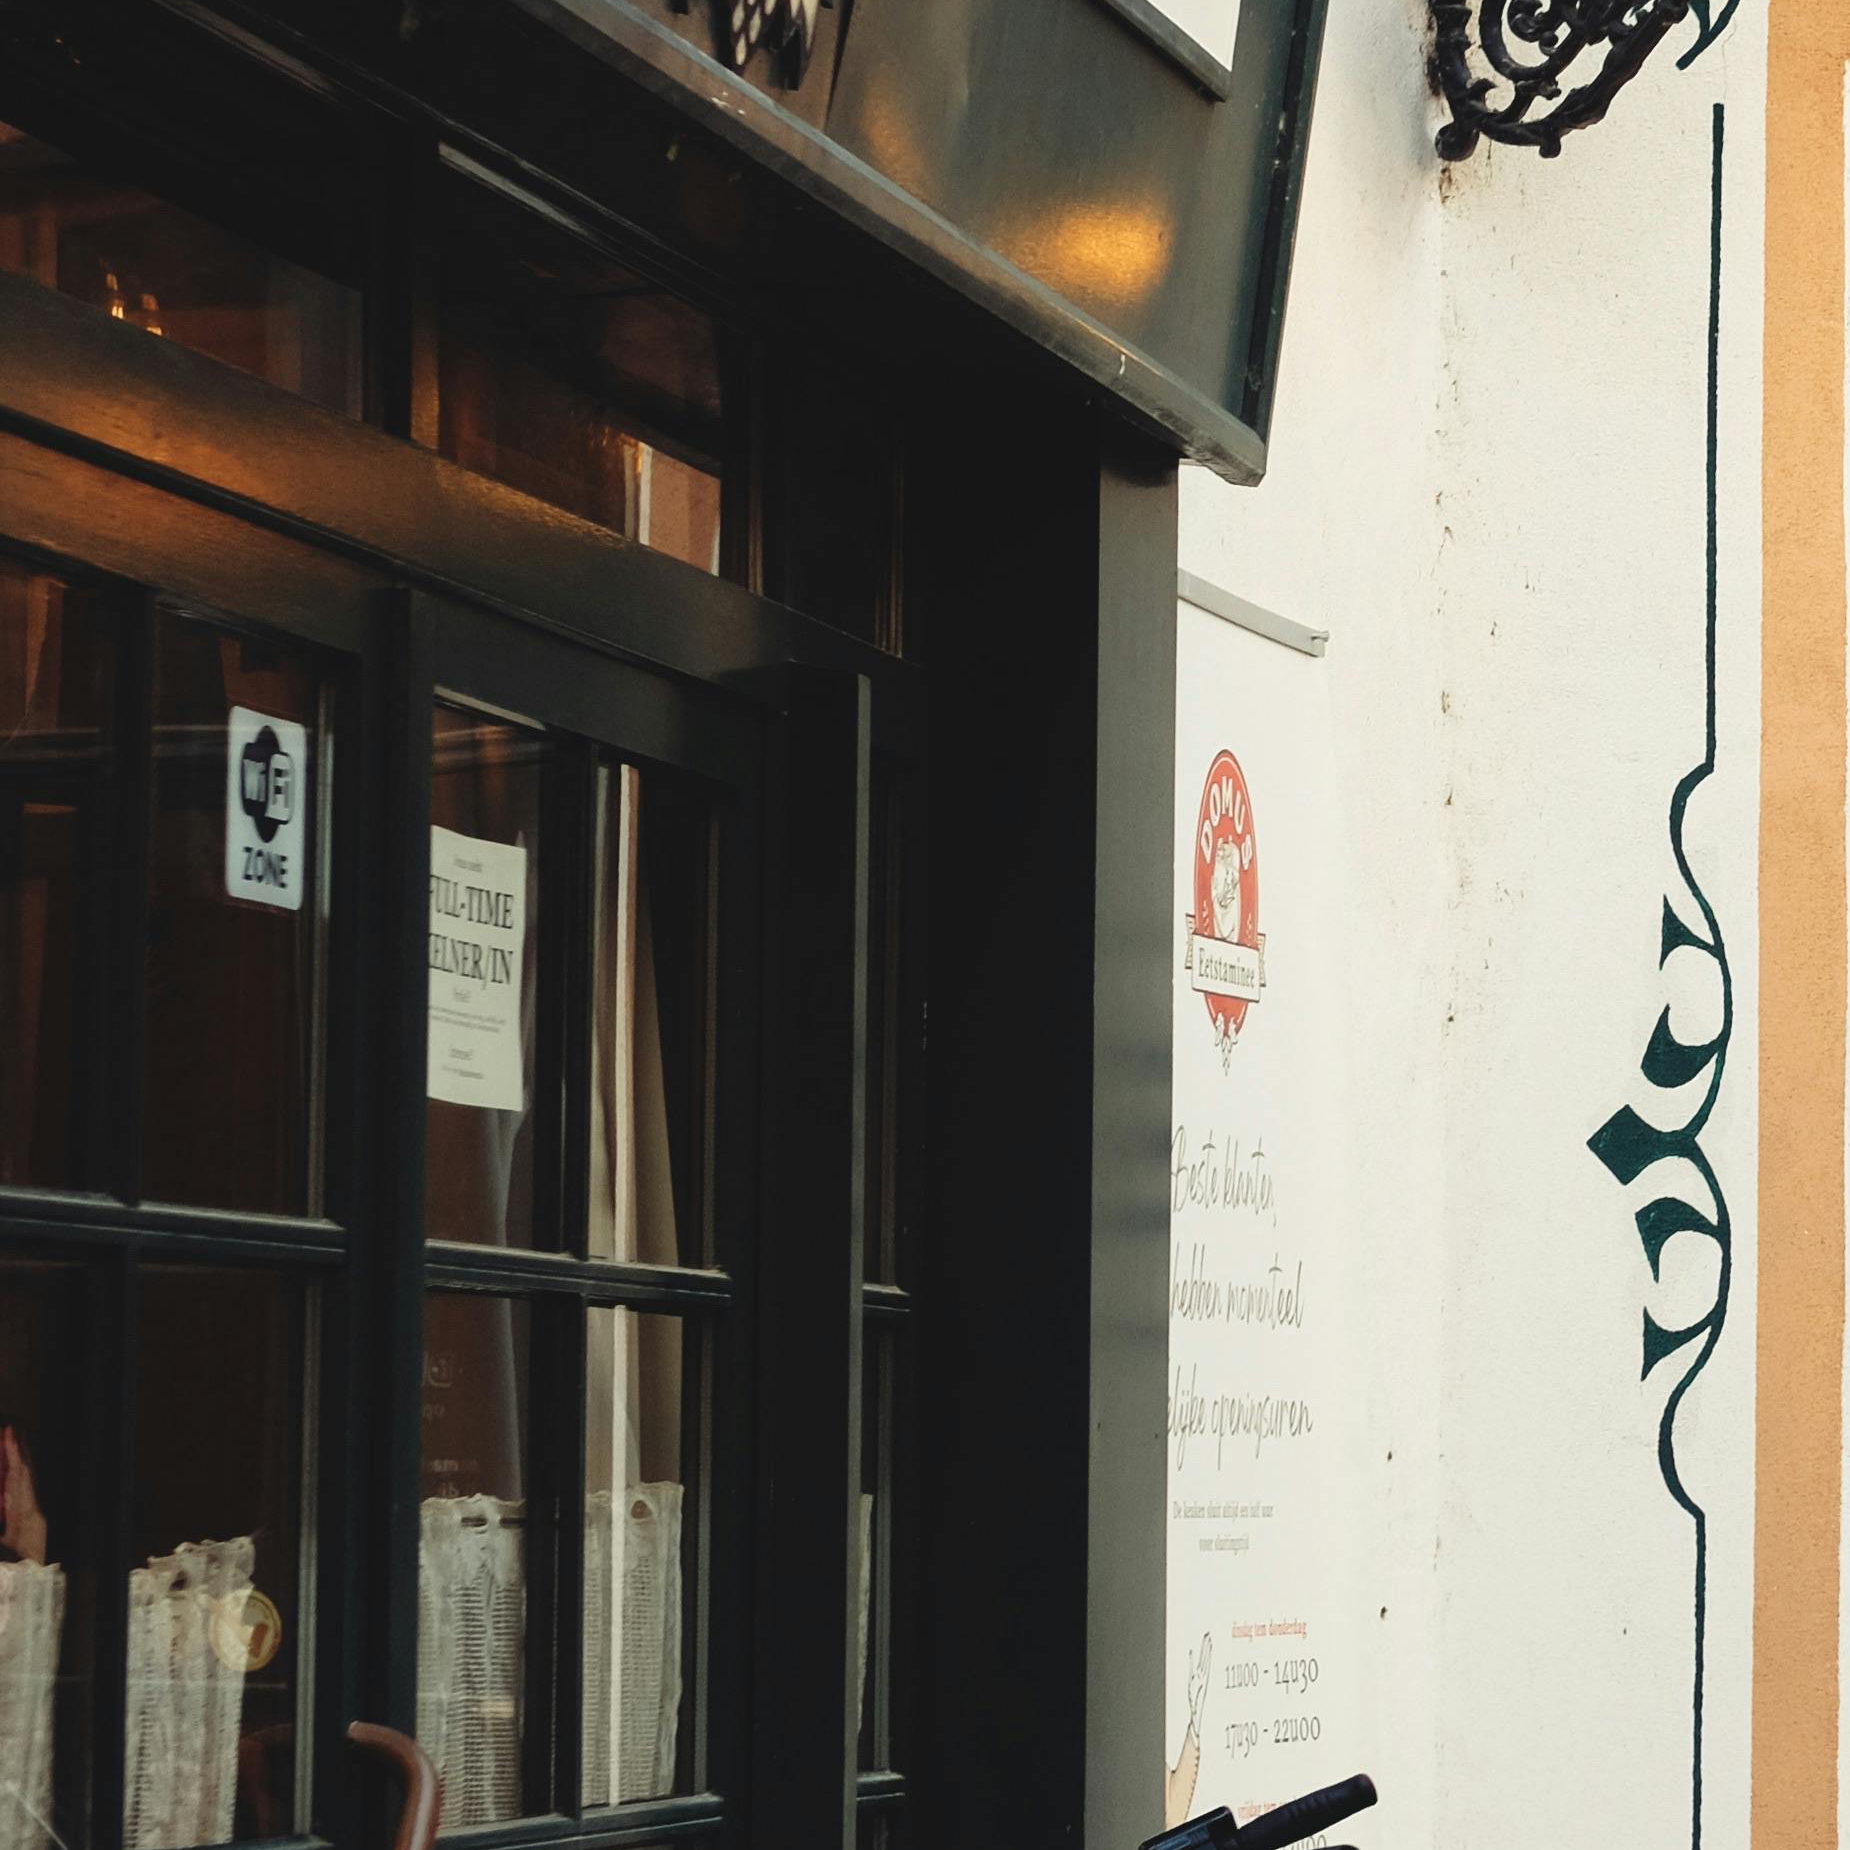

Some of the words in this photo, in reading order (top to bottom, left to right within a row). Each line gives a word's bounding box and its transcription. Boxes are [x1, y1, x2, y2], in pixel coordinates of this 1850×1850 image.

[1200, 775, 1253, 871] DOMUS
[243, 846, 288, 889] ZONE
[429, 933, 513, 990] ELNER/IN
[1170, 1241, 1222, 1321] hebben
[1211, 1391, 1314, 1471] openingsuren
